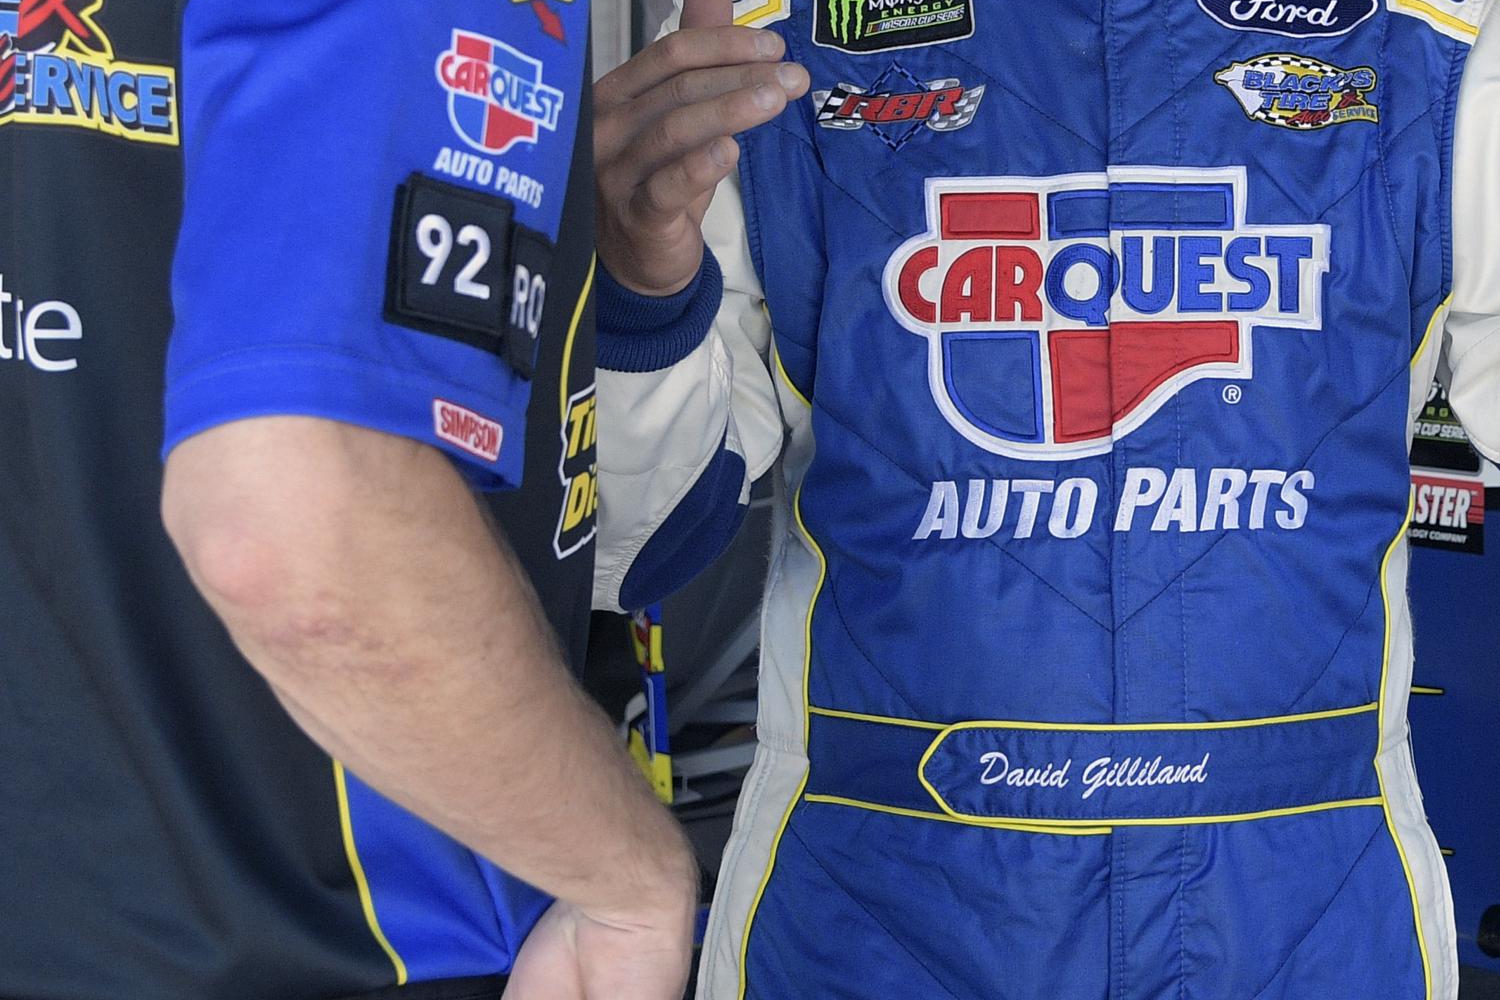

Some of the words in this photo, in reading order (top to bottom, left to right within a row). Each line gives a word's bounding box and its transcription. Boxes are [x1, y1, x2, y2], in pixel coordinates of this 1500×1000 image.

[881, 17, 917, 31] NASCAR
[917, 14, 937, 25] CUP
[936, 7, 965, 21] SERIES
[14, 53, 170, 128] ERVICE
[440, 54, 562, 128] CARQUEST
[1242, 69, 1374, 92] BLACK'S
[1261, 91, 1331, 110] TIRE
[433, 147, 494, 186] AUTO
[494, 166, 545, 209] PARTS
[415, 213, 491, 300] 92
[898, 235, 1314, 327] CARQUEST
[440, 406, 499, 459] SIMPSON
[567, 394, 597, 460] Ti
[911, 477, 1099, 540] AUTO
[1113, 467, 1316, 533] PARTS
[1411, 482, 1471, 529] STER
[1429, 530, 1468, 545] COMPANY
[979, 750, 1072, 789] David
[1081, 752, 1210, 800] Gilliland
